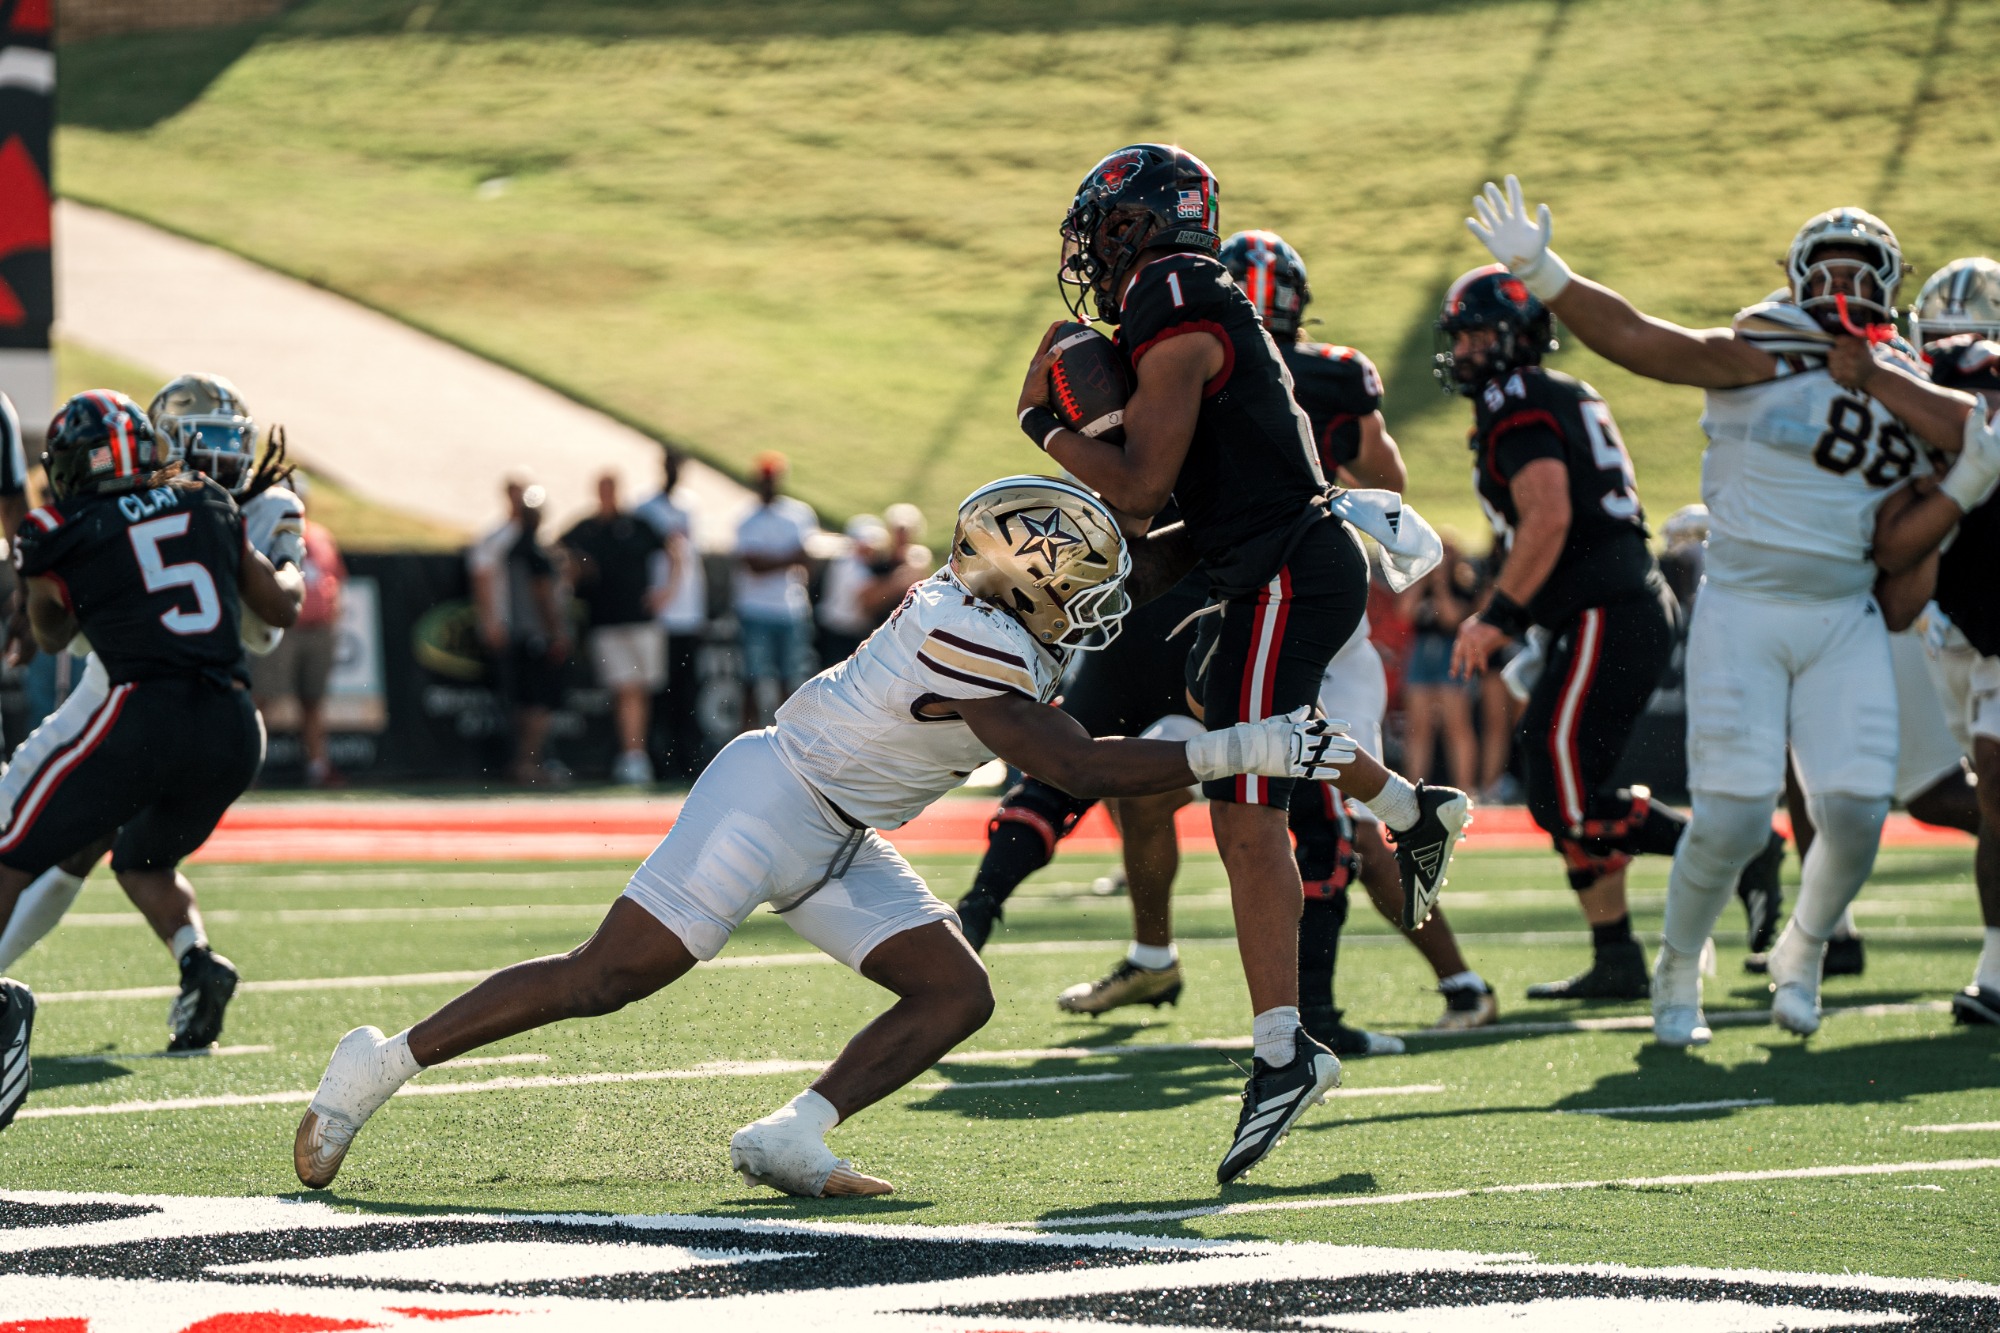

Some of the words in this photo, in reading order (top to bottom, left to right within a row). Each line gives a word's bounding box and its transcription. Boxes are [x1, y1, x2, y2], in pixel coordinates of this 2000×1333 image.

[1177, 204, 1203, 218] SBC
[1165, 271, 1185, 309] 1
[1483, 373, 1527, 413] 54
[1813, 396, 1916, 489] 88
[128, 513, 221, 635] 5
